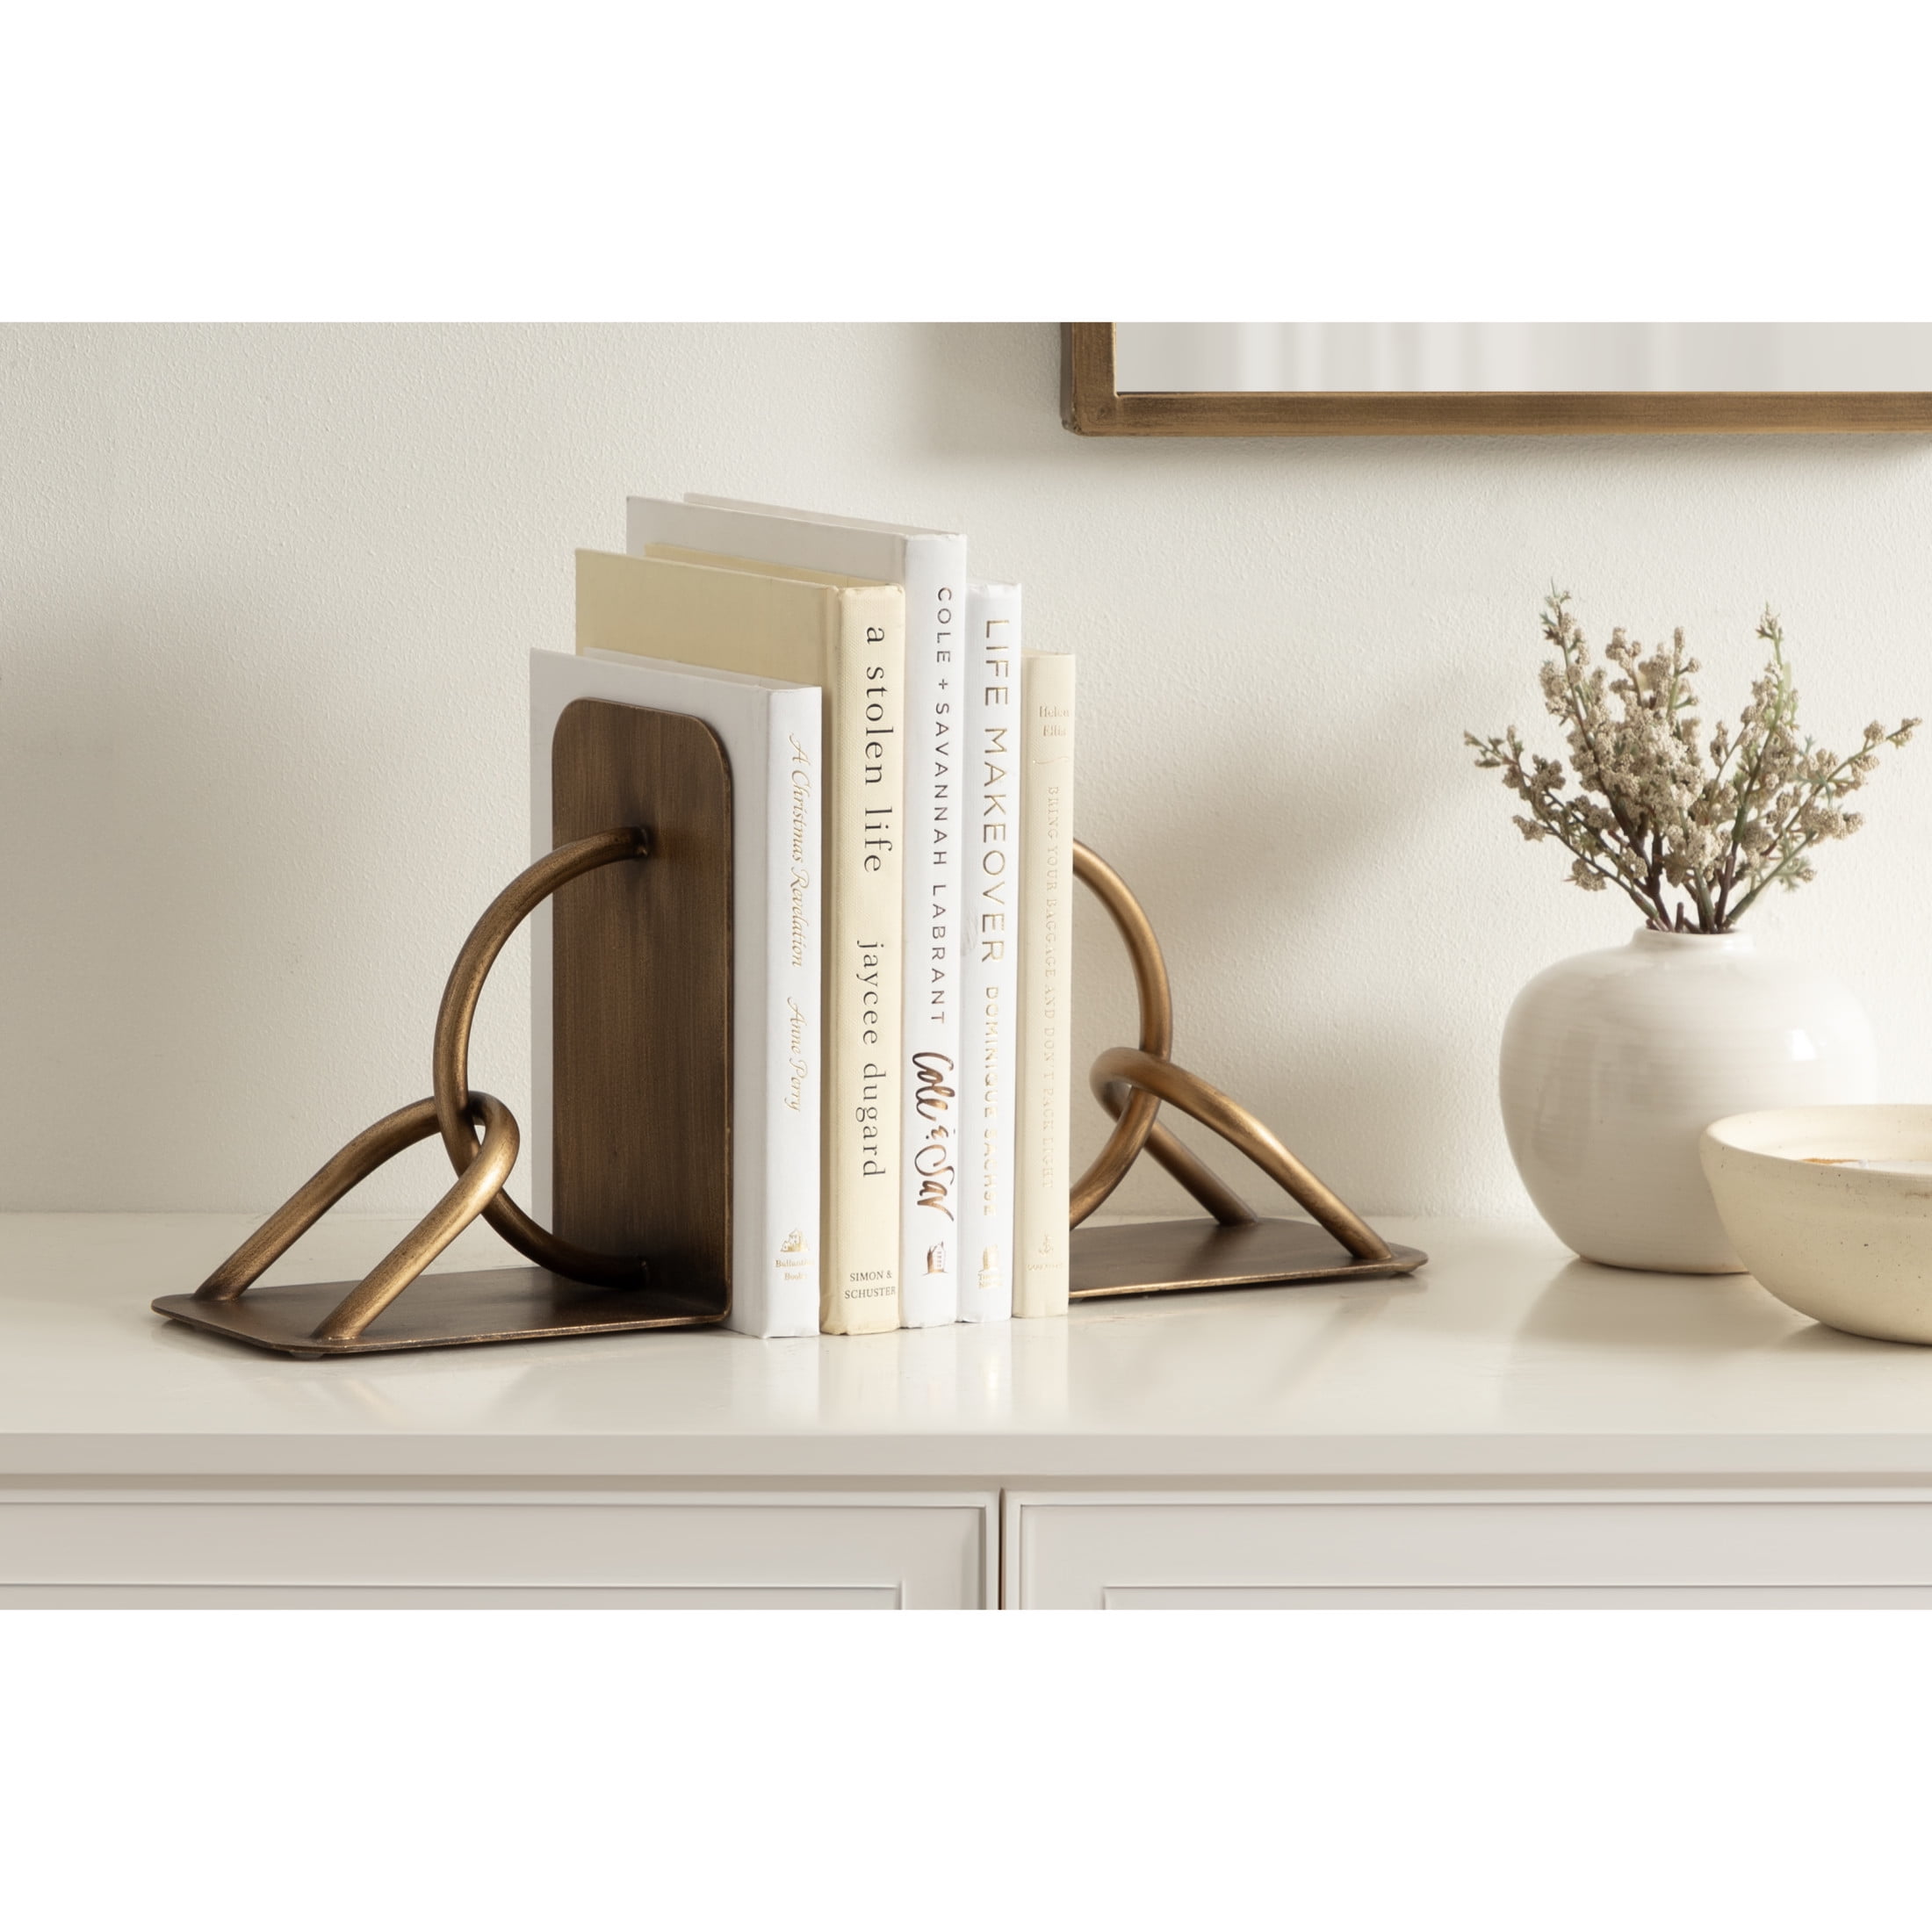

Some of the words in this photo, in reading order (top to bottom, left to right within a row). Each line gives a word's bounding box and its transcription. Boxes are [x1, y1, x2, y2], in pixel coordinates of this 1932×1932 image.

[866, 626, 885, 645] a
[936, 587, 953, 664] COLE
[938, 678, 948, 690] +
[984, 619, 1010, 706] LIFE
[789, 732, 811, 766] A
[865, 666, 894, 786] stolen
[791, 769, 812, 863] Christmas
[933, 702, 949, 865] SAVANNAH
[1047, 786, 1059, 840] BRING
[863, 805, 893, 872] life
[981, 727, 1008, 962] MAKEOVER
[1046, 845, 1058, 891] YOUR
[789, 866, 810, 967] Revelation
[1044, 898, 1057, 977] BAGGAGE
[931, 884, 947, 1024] LABRANT
[787, 996, 808, 1056] Anne
[855, 940, 885, 1045] jaycee
[1043, 984, 1056, 1020] AND
[784, 1057, 808, 1113] Perry
[912, 1051, 955, 1121] Cole
[984, 986, 998, 1118] DOMINIQUE
[1042, 1027, 1055, 1081] DON'T
[855, 1063, 887, 1178] dugard
[1042, 1087, 1055, 1131] PACK
[914, 1143, 955, 1222] Sav
[983, 1128, 998, 1216] SACHSE
[1042, 1136, 1054, 1188] LIGHT
[784, 1272, 807, 1281] Book
[844, 1286, 896, 1300] SCHUSTER
[849, 1271, 883, 1282] SIMON
[886, 1270, 892, 1279] &
